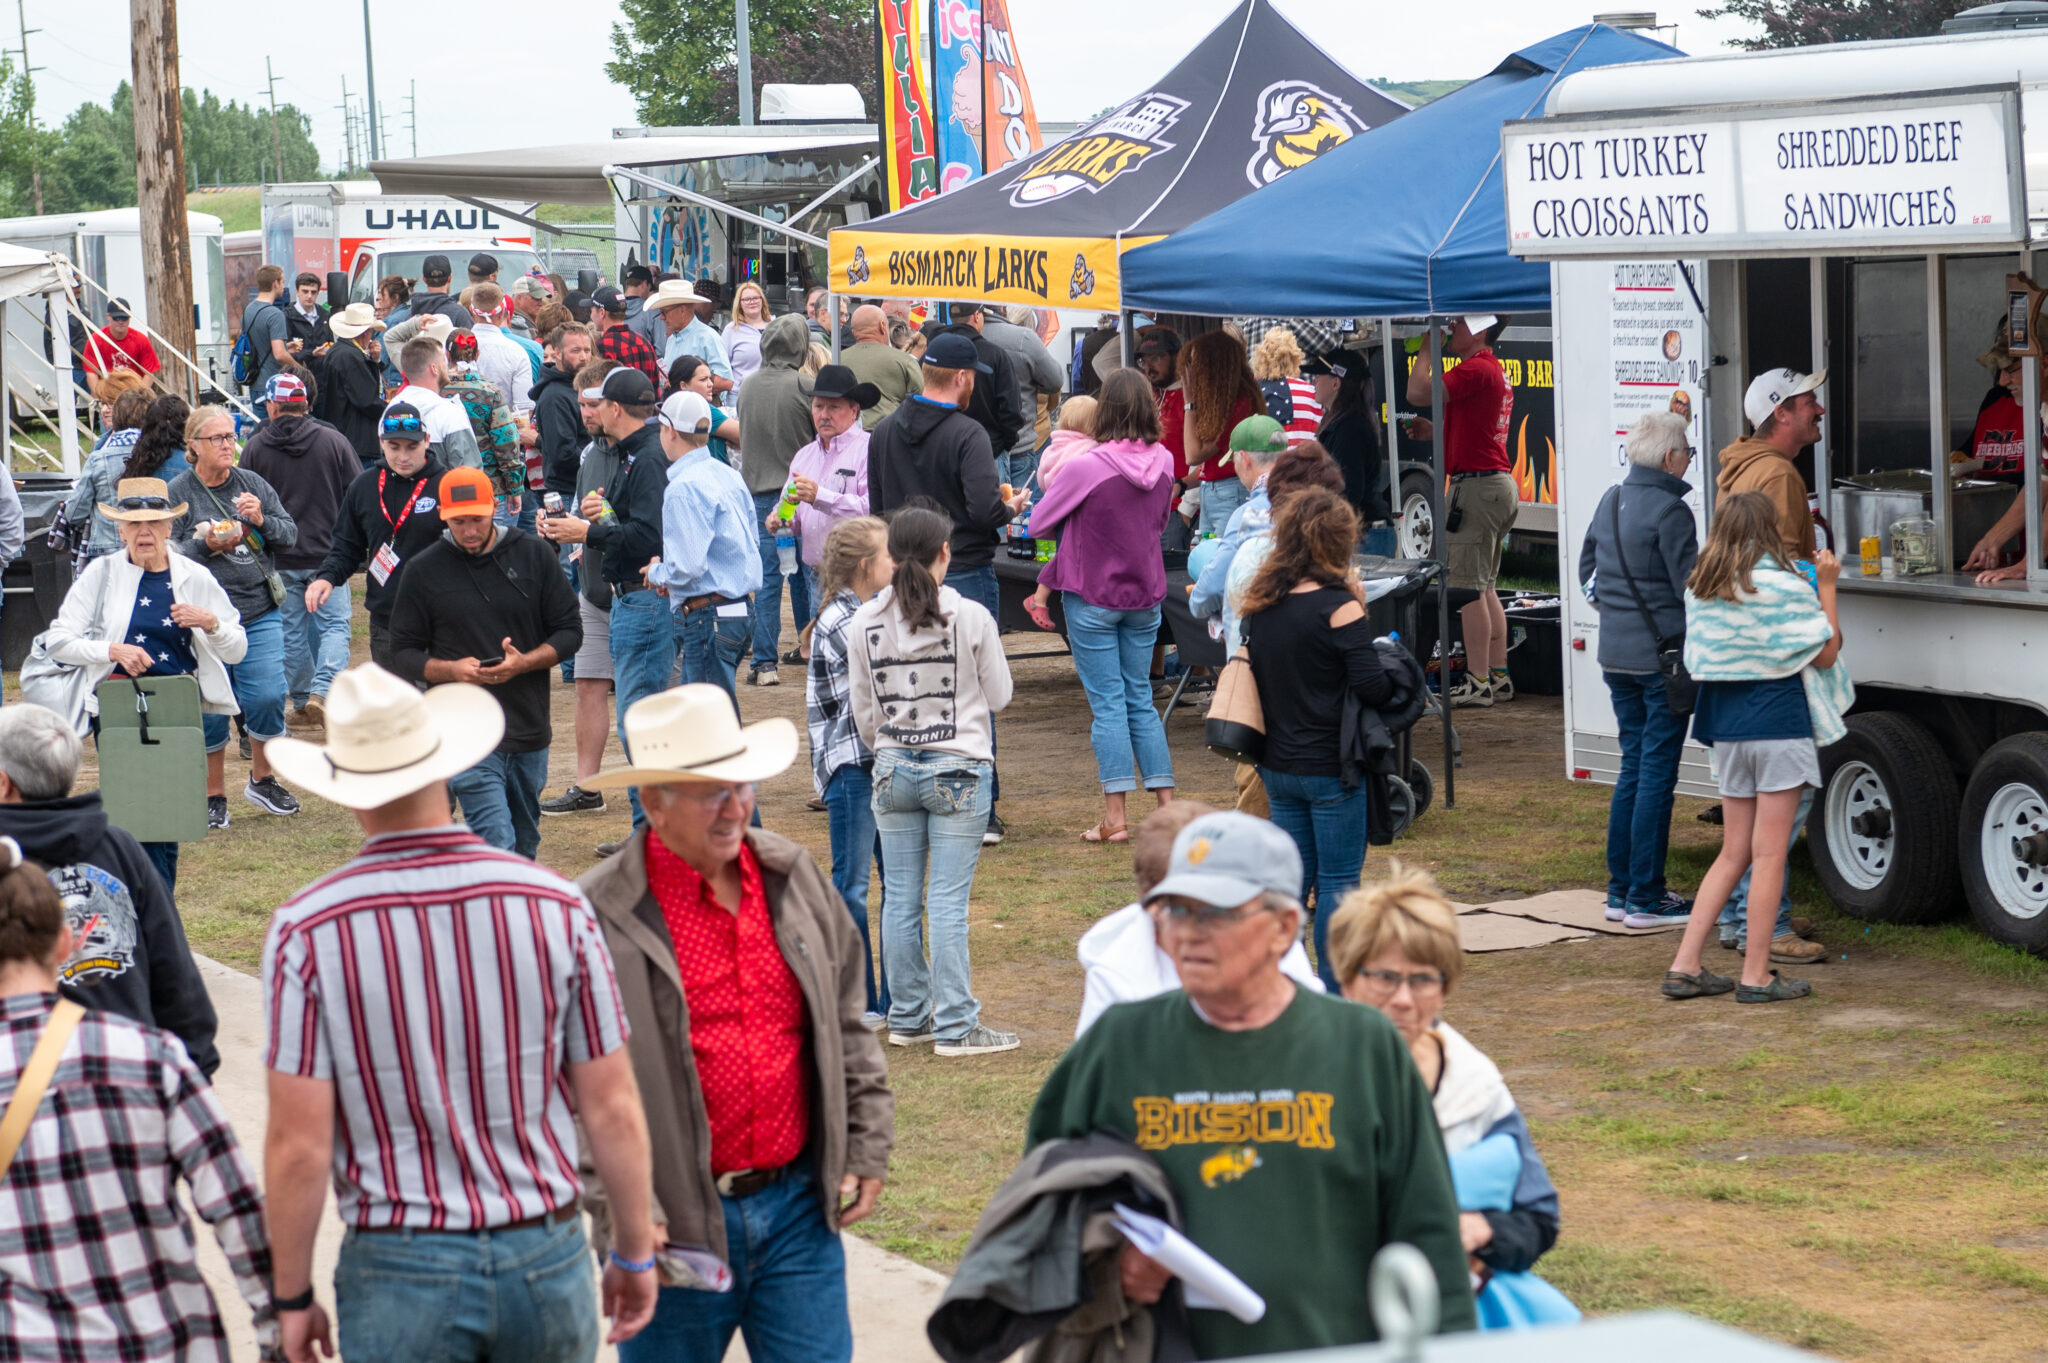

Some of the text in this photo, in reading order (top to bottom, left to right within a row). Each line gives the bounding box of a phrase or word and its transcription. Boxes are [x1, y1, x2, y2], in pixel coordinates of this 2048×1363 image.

[998, 71, 1032, 168] DO
[1019, 136, 1152, 184] LARKS
[1528, 133, 1708, 182] HOT TURKEY
[1777, 120, 1963, 170] SHREDDED BEEF
[365, 208, 500, 230] U-HAUL
[1532, 193, 1709, 238] CROISSANTS
[1784, 186, 1957, 231] SANDWICHES
[889, 246, 1049, 299] BISMARCK LARKS
[1526, 360, 1556, 388] BAR
[1614, 359, 1642, 382] SHREDDED
[1643, 360, 1656, 382] BEEF
[1688, 359, 1698, 384] 10
[1133, 1091, 1336, 1150] BISON
